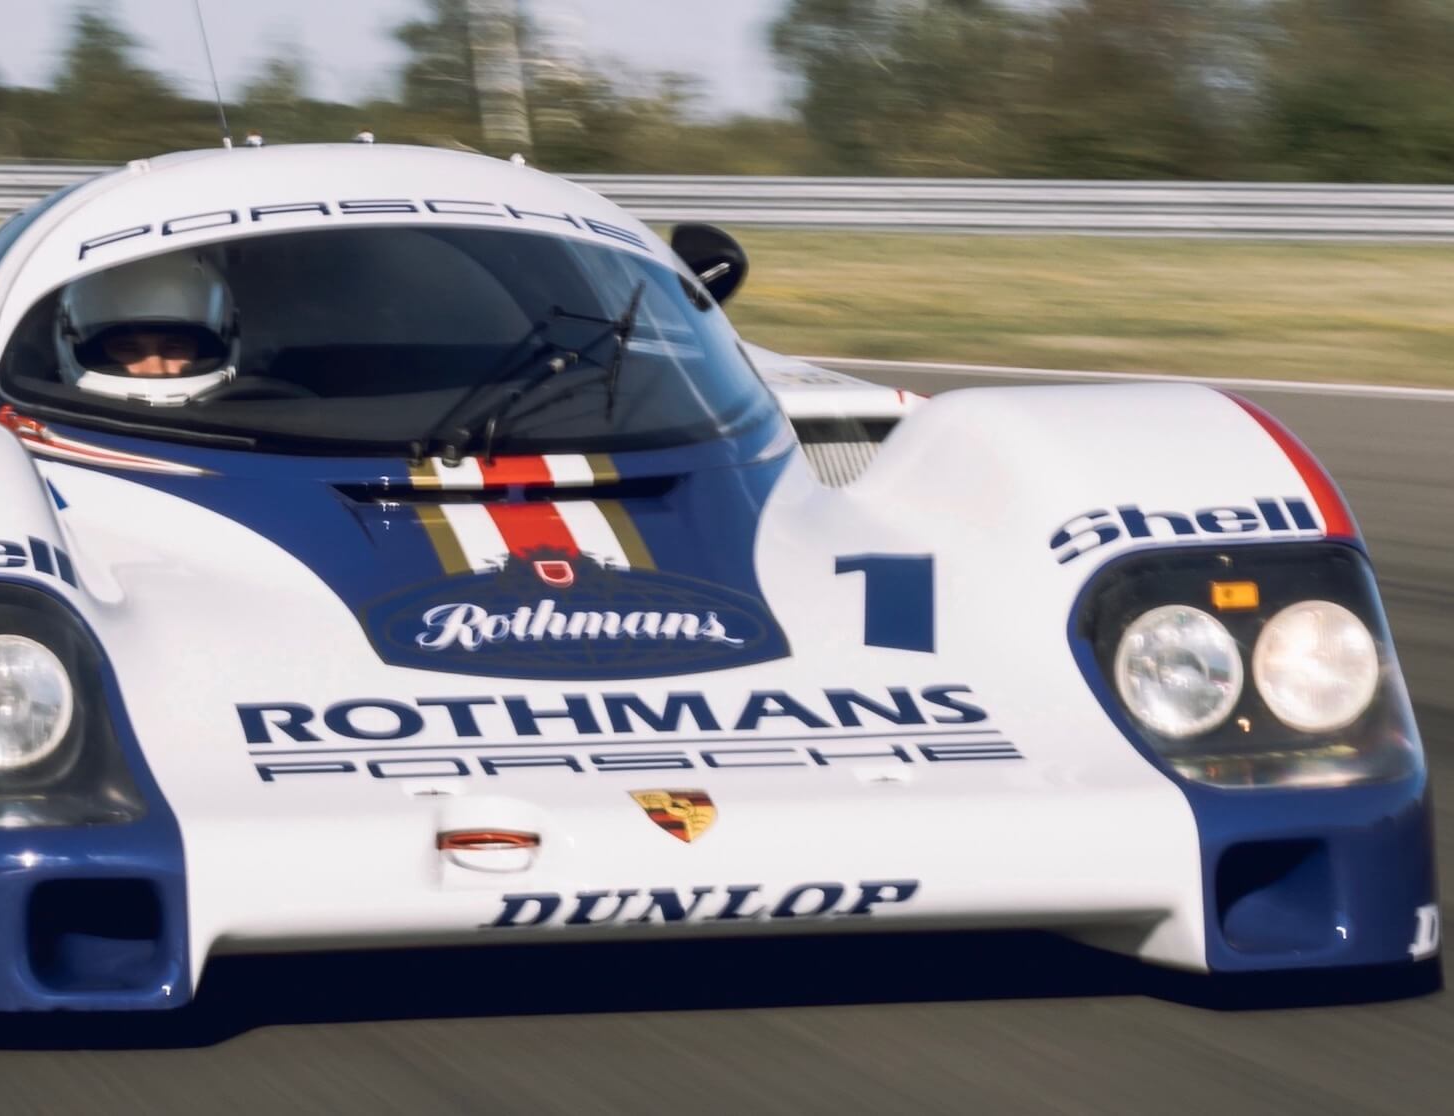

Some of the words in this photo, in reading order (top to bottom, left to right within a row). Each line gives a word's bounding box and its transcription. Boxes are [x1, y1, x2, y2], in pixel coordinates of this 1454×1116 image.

[79, 200, 652, 261] PORSCHE
[1050, 497, 1325, 564] Shell
[414, 600, 745, 653] Rothmans
[835, 553, 935, 654] 1
[236, 684, 989, 745] ROTHMANS
[250, 741, 1025, 782] PORSCHE
[481, 880, 921, 929] DUNLOP
